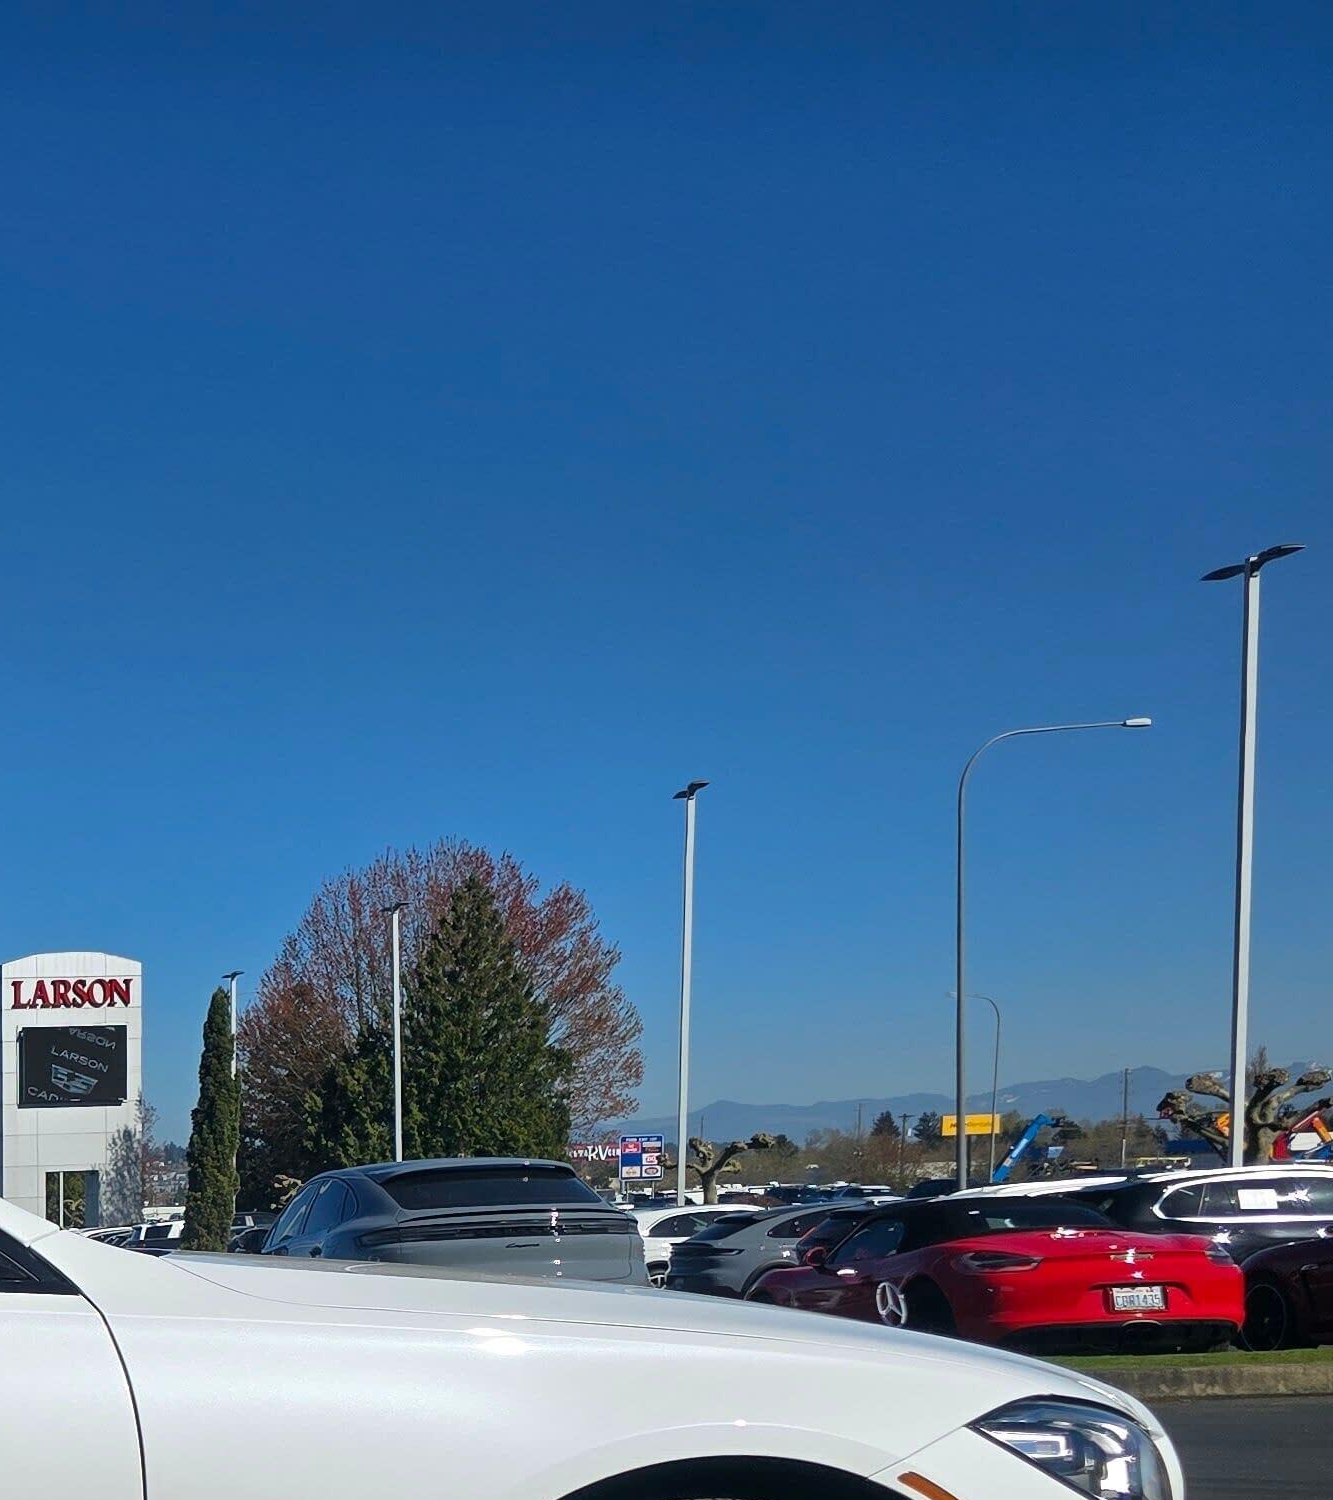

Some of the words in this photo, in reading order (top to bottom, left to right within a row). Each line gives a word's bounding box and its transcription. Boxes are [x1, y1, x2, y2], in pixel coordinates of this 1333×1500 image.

[11, 978, 133, 1009] LARSON
[51, 1045, 109, 1073] LARSON
[587, 1144, 609, 1162] RV
